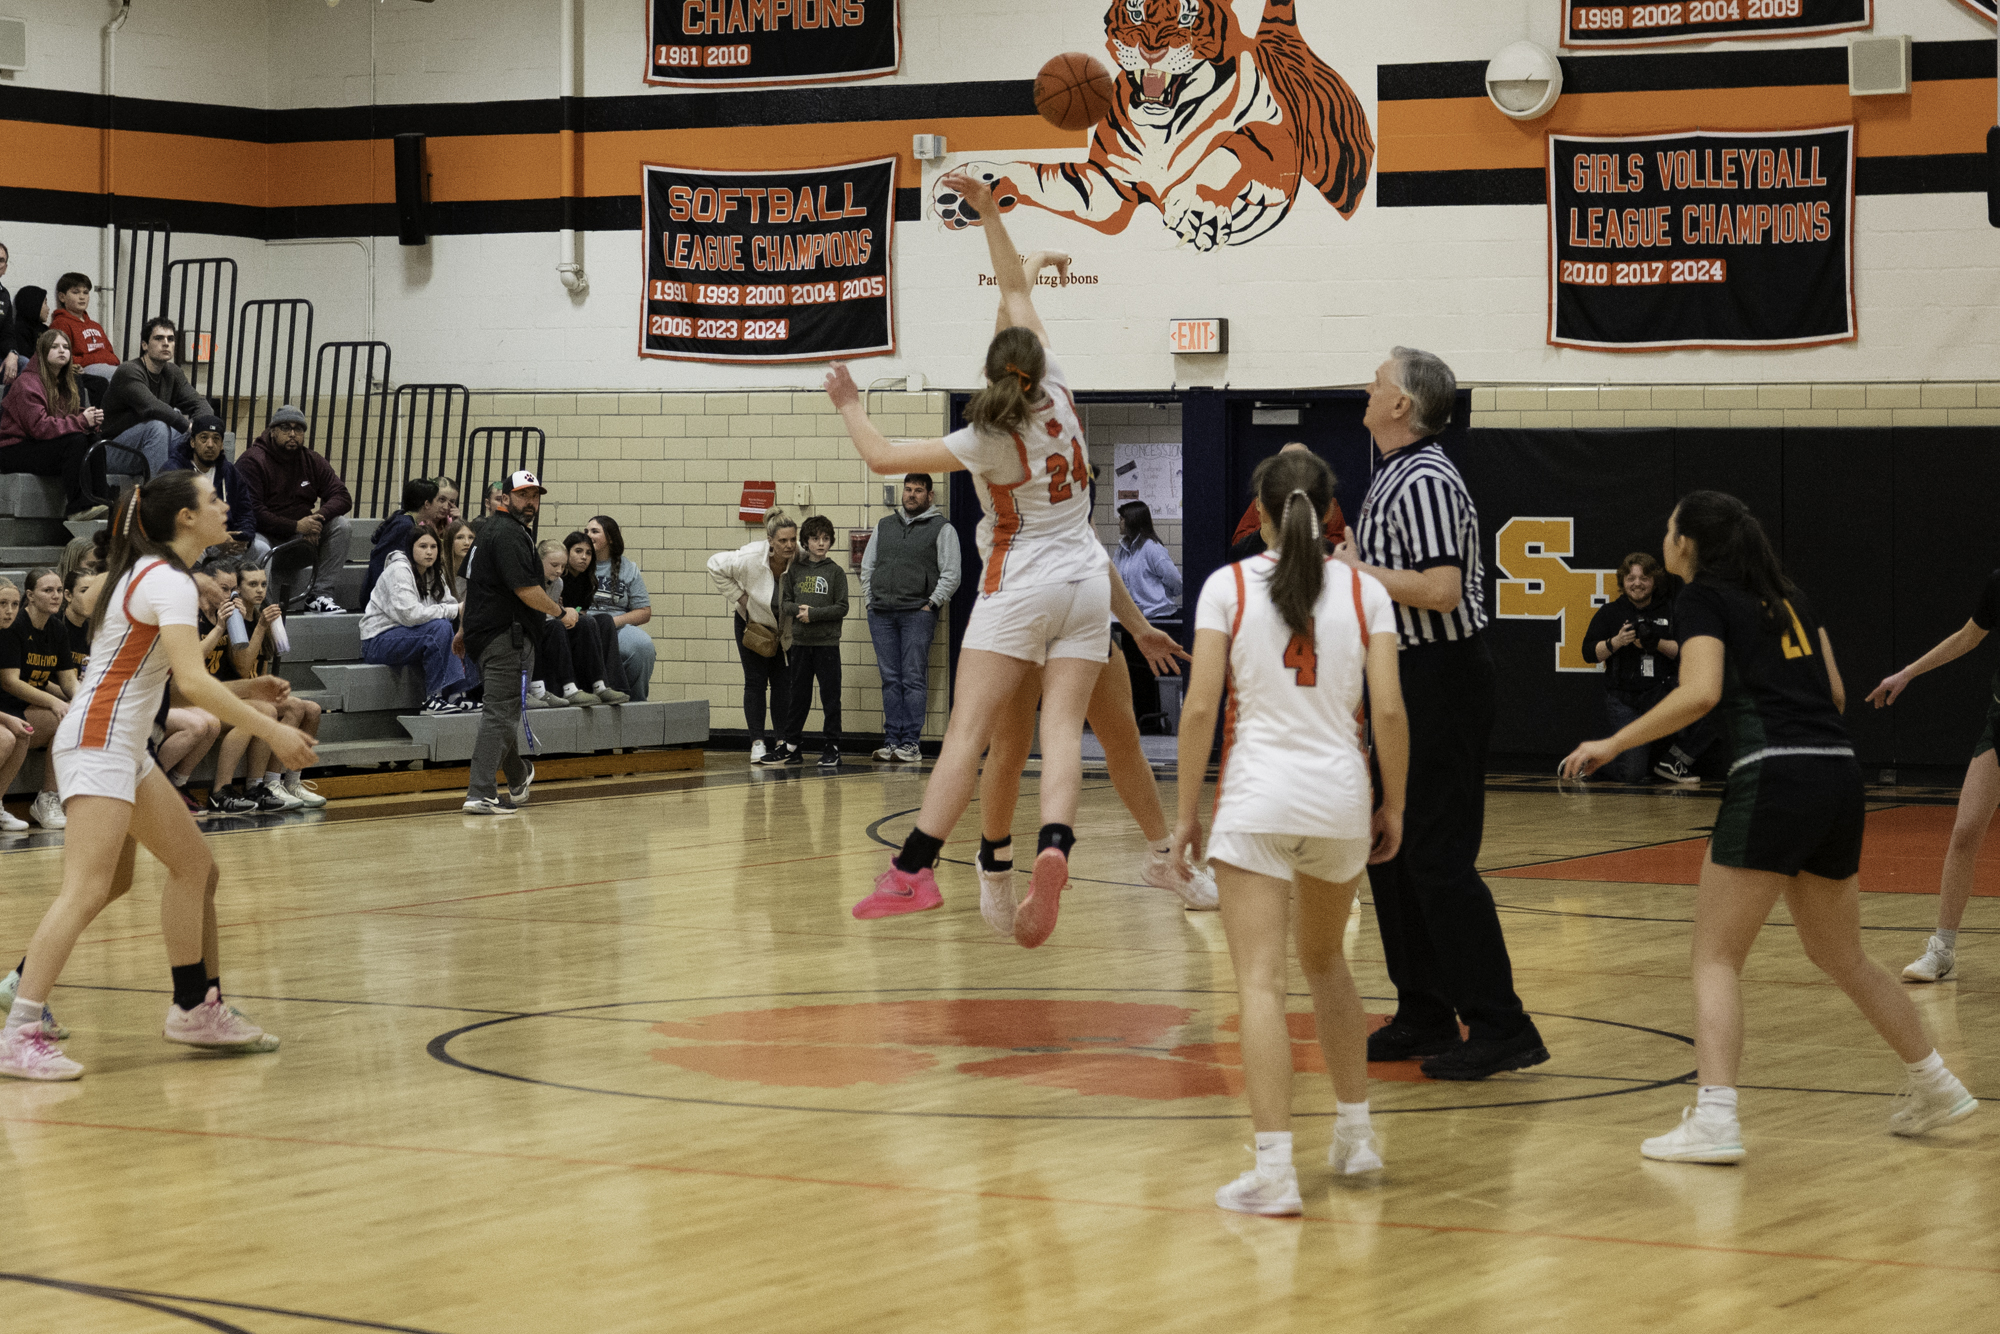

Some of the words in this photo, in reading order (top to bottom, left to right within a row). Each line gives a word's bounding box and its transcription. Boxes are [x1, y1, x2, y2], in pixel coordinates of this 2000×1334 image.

[682, 0, 865, 35] CHAMPIONS
[1578, 8, 1624, 29] 1998
[1632, 5, 1682, 27] 2002
[1689, 0, 1740, 23] 2004
[1747, 0, 1799, 19] 2009
[658, 46, 698, 65] 1981
[707, 46, 749, 65] 2010
[1573, 153, 1644, 193] GIRLS
[1656, 146, 1827, 191] VOLLEYBALL
[668, 182, 867, 224] SOFTBALL
[1569, 206, 1672, 248] LEAGUE
[1682, 201, 1831, 245] CHAMPIONS
[663, 231, 745, 271] LEAGUE
[751, 228, 873, 271] CHAMPIONS
[1563, 261, 1608, 284] 2010
[1615, 262, 1665, 284] 2017
[1671, 260, 1723, 281] 2024
[653, 281, 688, 302] 1991
[697, 285, 739, 304] 1993
[745, 286, 786, 305] 2000
[791, 282, 836, 304] 2004
[842, 277, 884, 299] 2005
[652, 316, 692, 336] 2006
[697, 319, 738, 339] 2023
[744, 319, 787, 339] 2024
[1177, 321, 1210, 350] EXIT
[1045, 435, 1088, 505] 24
[26, 652, 58, 668] SOUTHW
[1283, 624, 1318, 687] 4
